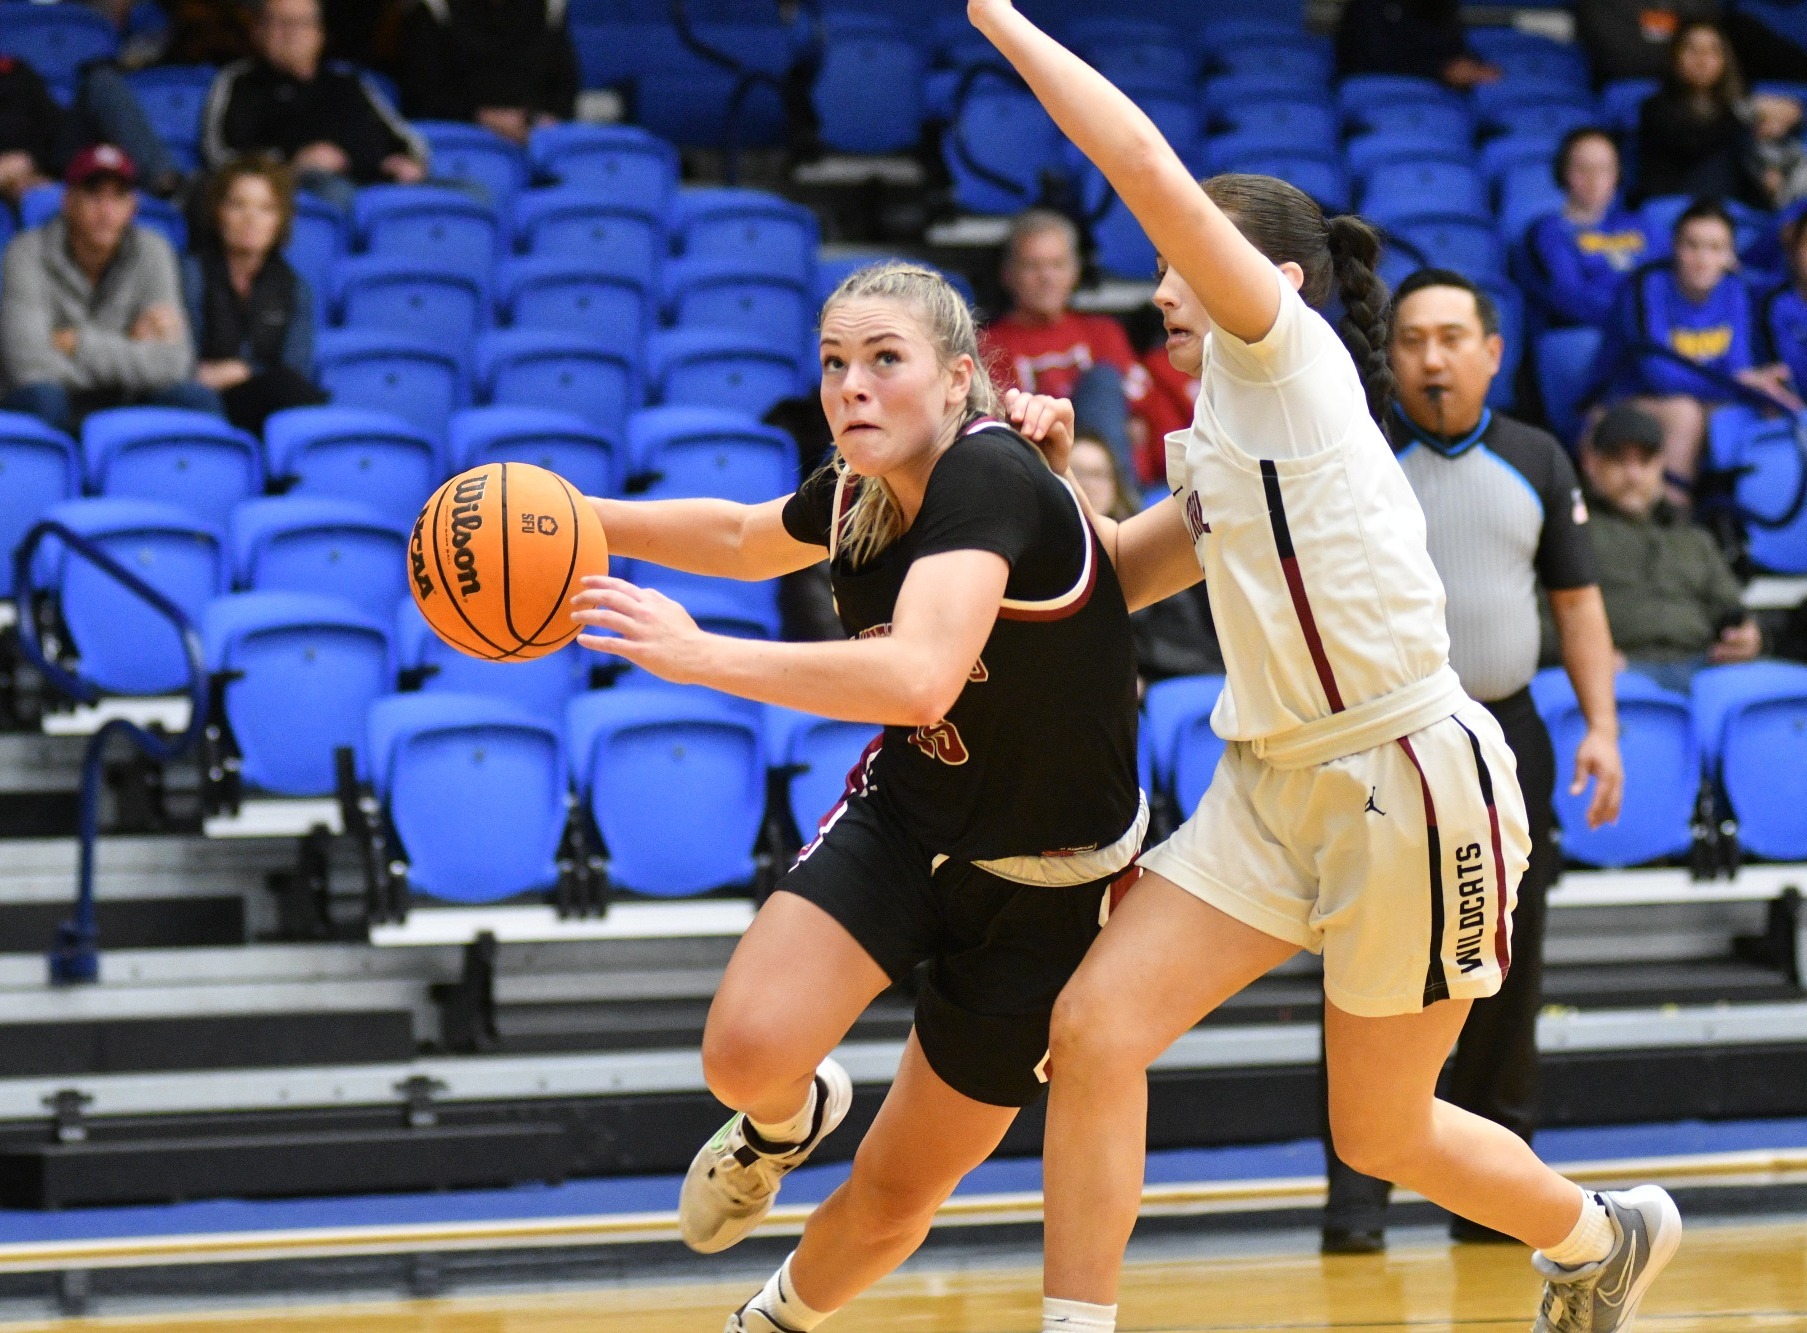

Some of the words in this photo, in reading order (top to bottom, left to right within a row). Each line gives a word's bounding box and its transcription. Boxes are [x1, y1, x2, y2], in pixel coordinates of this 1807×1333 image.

[410, 504, 435, 601] NCAA
[452, 474, 489, 598] Wilson
[521, 513, 535, 534] SFU
[1455, 842, 1485, 974] WILDCATS
